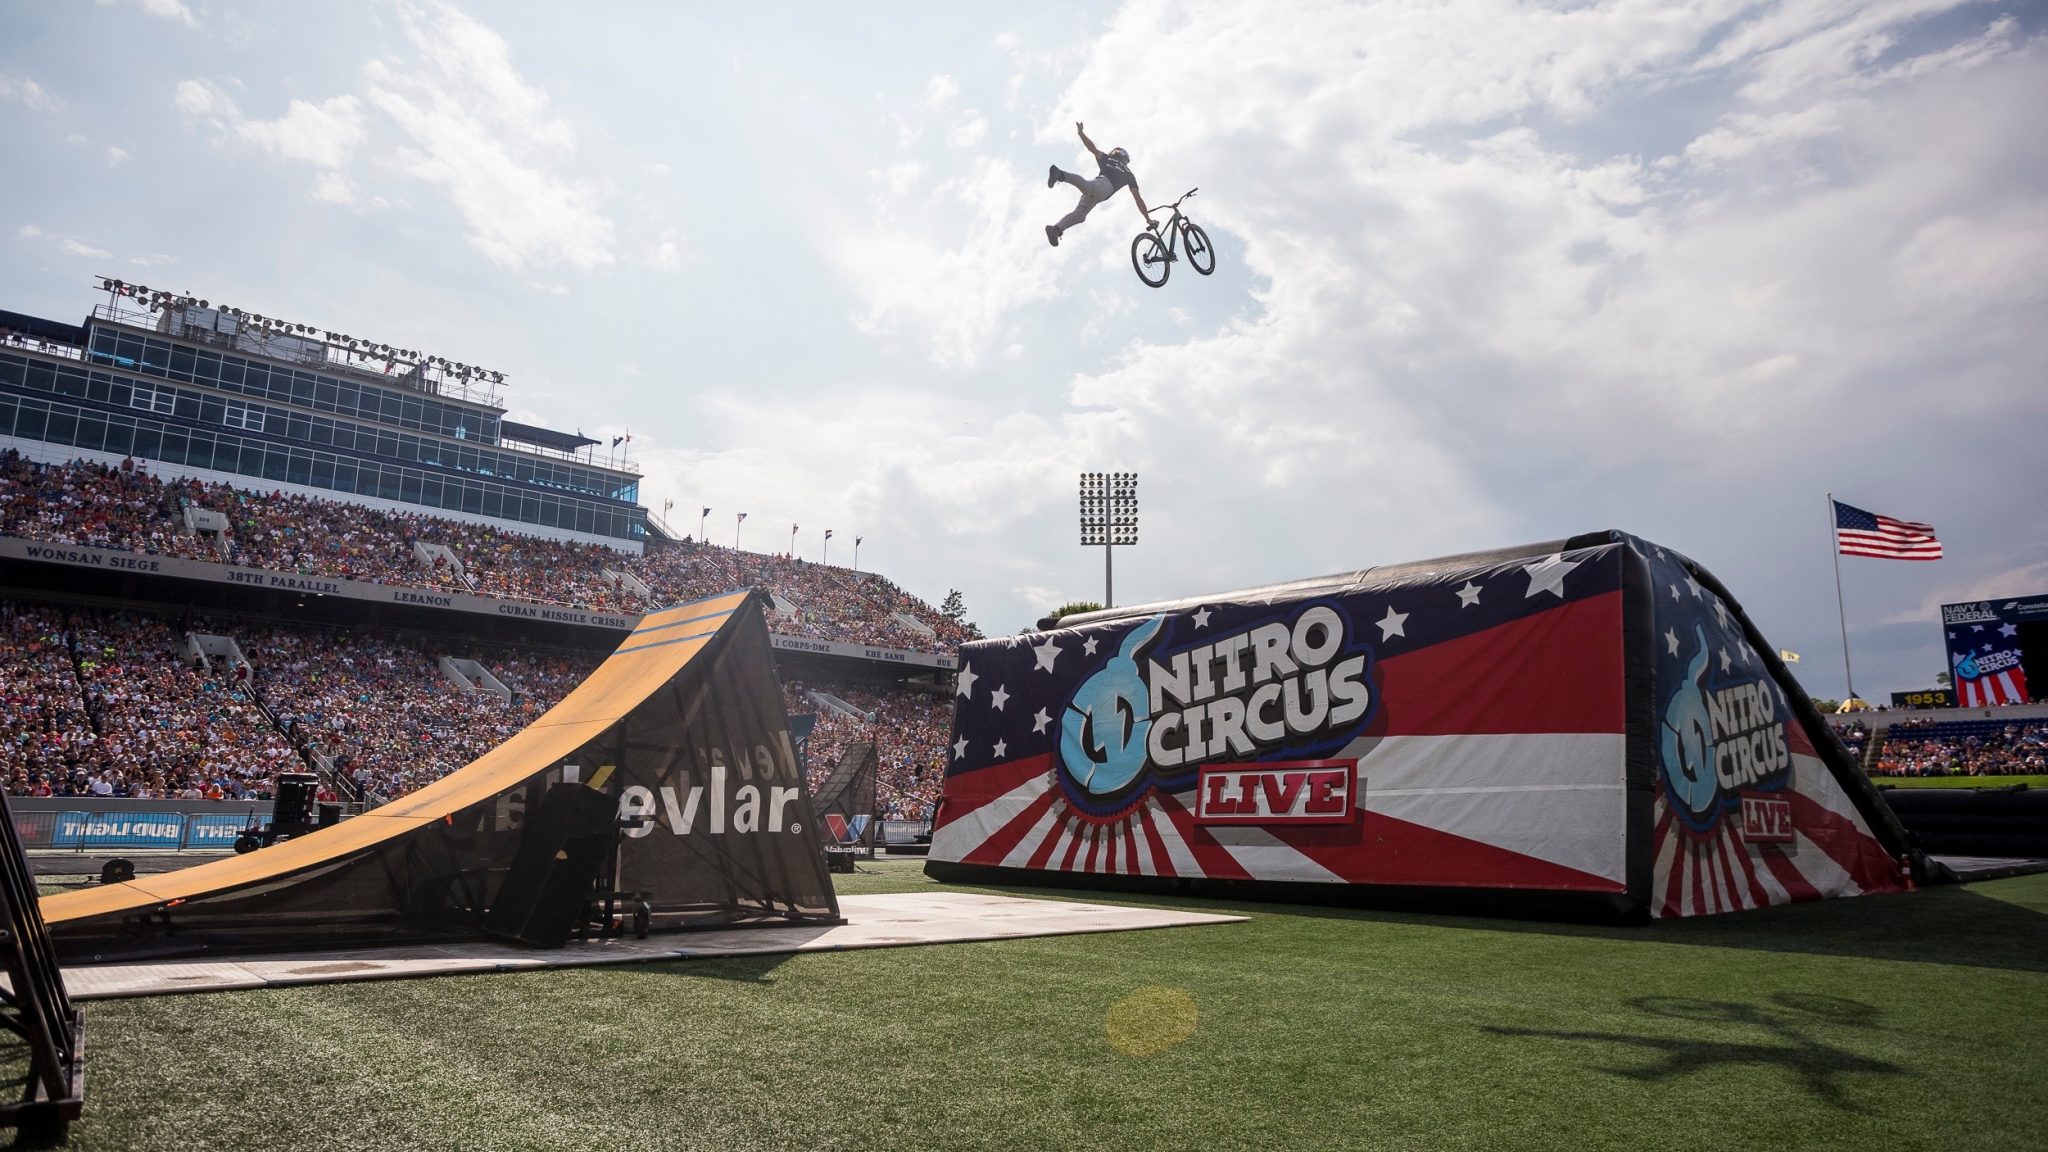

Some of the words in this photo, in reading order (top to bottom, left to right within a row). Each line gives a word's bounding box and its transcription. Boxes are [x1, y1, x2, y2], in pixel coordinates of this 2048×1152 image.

[26, 546, 102, 565] WONSAN
[110, 556, 160, 572] SIEGE
[227, 571, 264, 585] 38TH
[270, 576, 341, 594] PARALLEL
[394, 591, 450, 607] LEBANON
[1944, 603, 1977, 614] NAVY
[499, 604, 536, 616] CUBAN
[541, 610, 586, 623] MISSILE
[591, 615, 626, 628] CRISIS
[1945, 610, 1997, 622] FEDERAL
[865, 649, 882, 659] KHE
[884, 652, 905, 662] SANH
[1149, 606, 1345, 715] NITRO
[1974, 650, 2012, 666] NITRO
[1978, 656, 2019, 674] CIRCUS
[1706, 679, 1775, 740] NITRO
[1904, 692, 1946, 705] 1953
[1148, 655, 1370, 768] CIRCUS
[1715, 722, 1789, 790] CIRCUS
[1203, 770, 1346, 815] LIVE
[1745, 800, 1791, 834] LIVE
